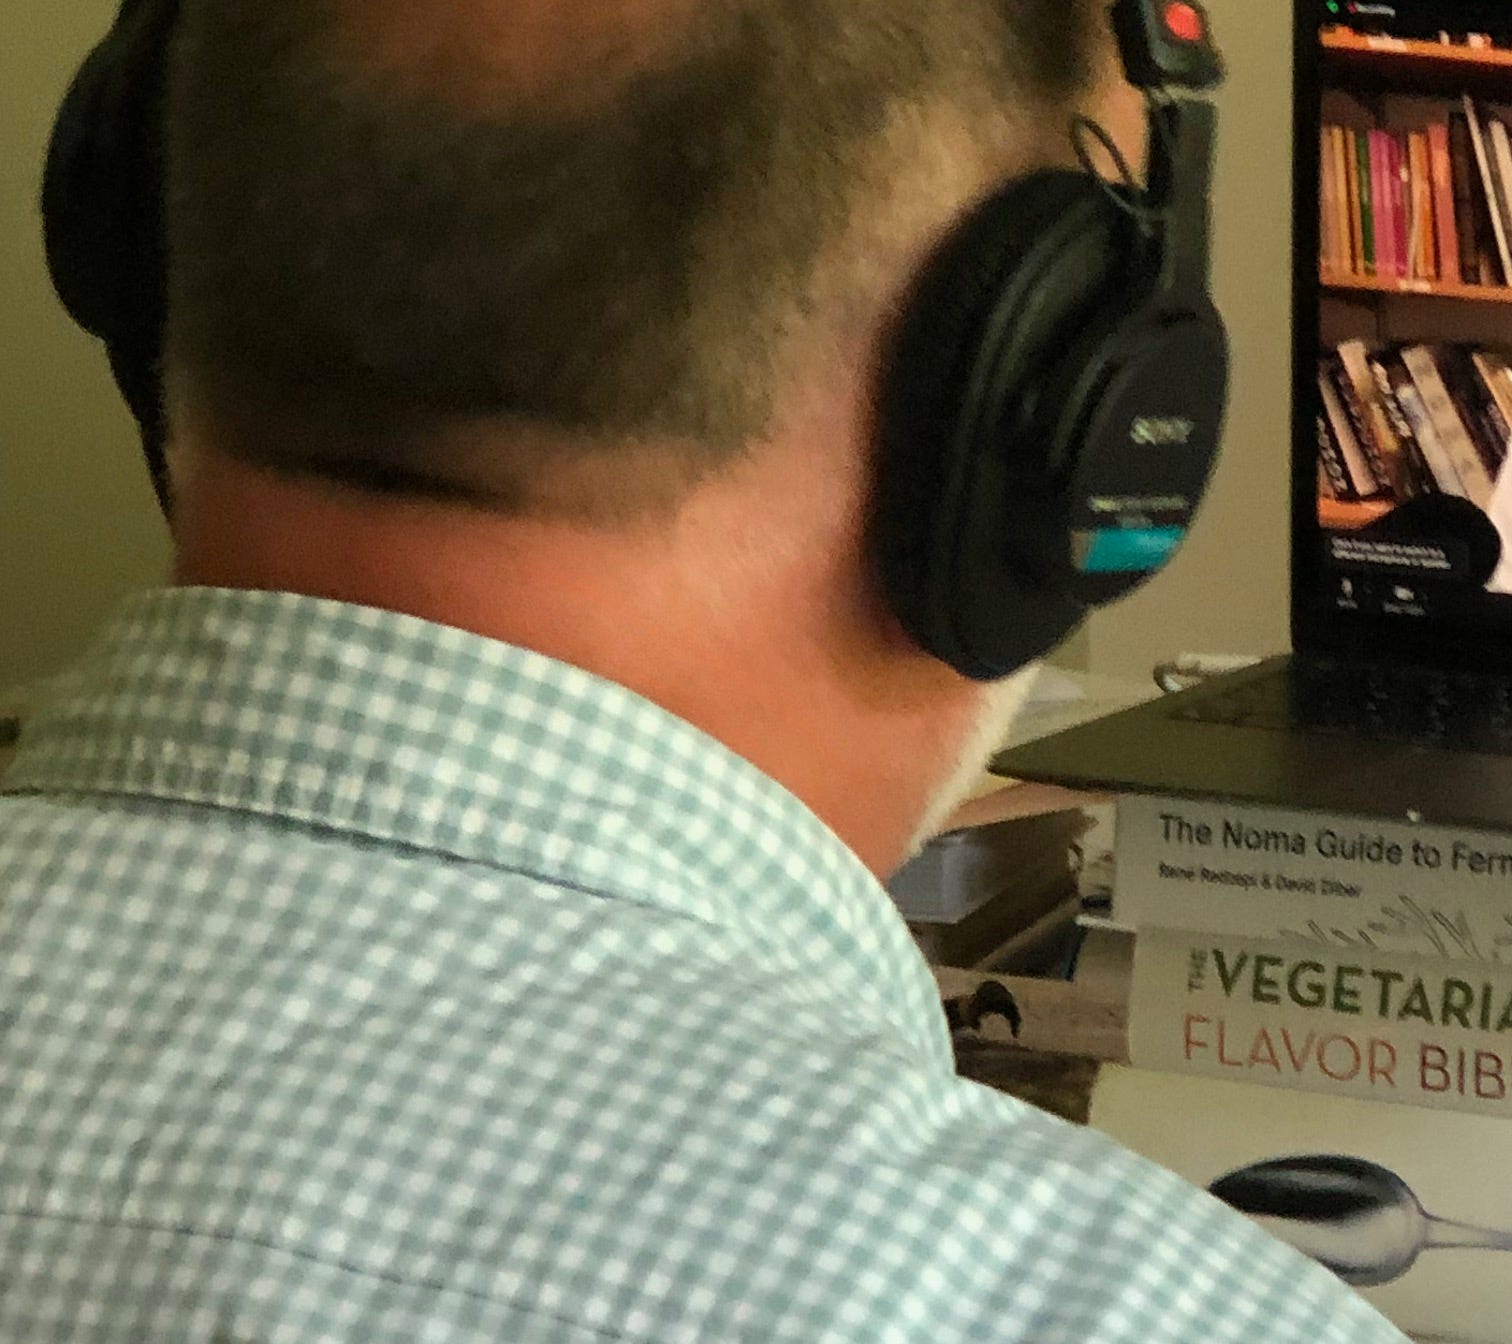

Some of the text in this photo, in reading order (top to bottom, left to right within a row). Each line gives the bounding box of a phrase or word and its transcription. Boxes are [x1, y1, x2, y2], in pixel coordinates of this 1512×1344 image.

[1160, 811, 1213, 845] The
[1223, 819, 1306, 856] Noma
[1315, 828, 1402, 865] Guide
[1412, 838, 1442, 869] to
[1187, 947, 1208, 994] THE
[1183, 1013, 1398, 1088] FLAVOR
